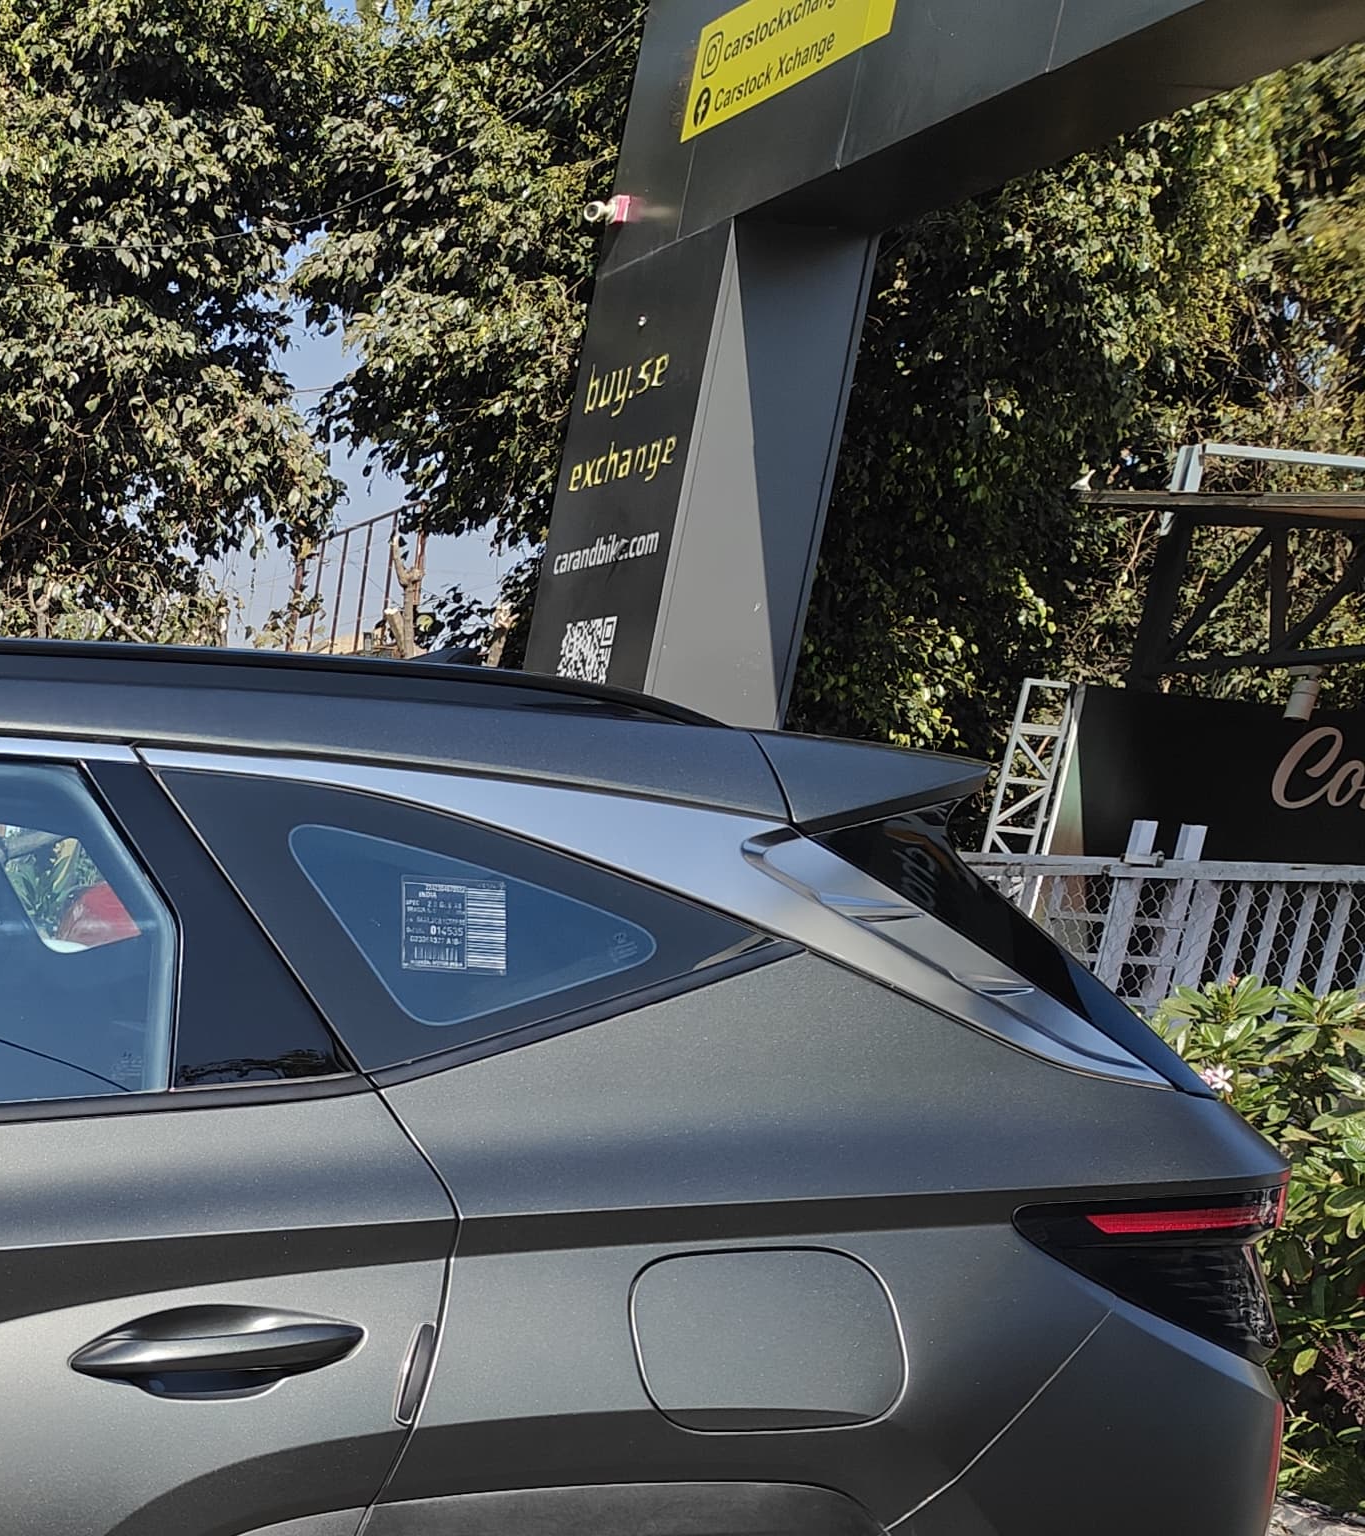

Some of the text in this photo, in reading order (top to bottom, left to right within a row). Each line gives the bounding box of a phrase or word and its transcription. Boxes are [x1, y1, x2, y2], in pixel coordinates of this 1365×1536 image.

[715, 32, 835, 112] Carstock Xchange
[568, 436, 677, 491] exchange
[1271, 726, 1365, 810] Co
